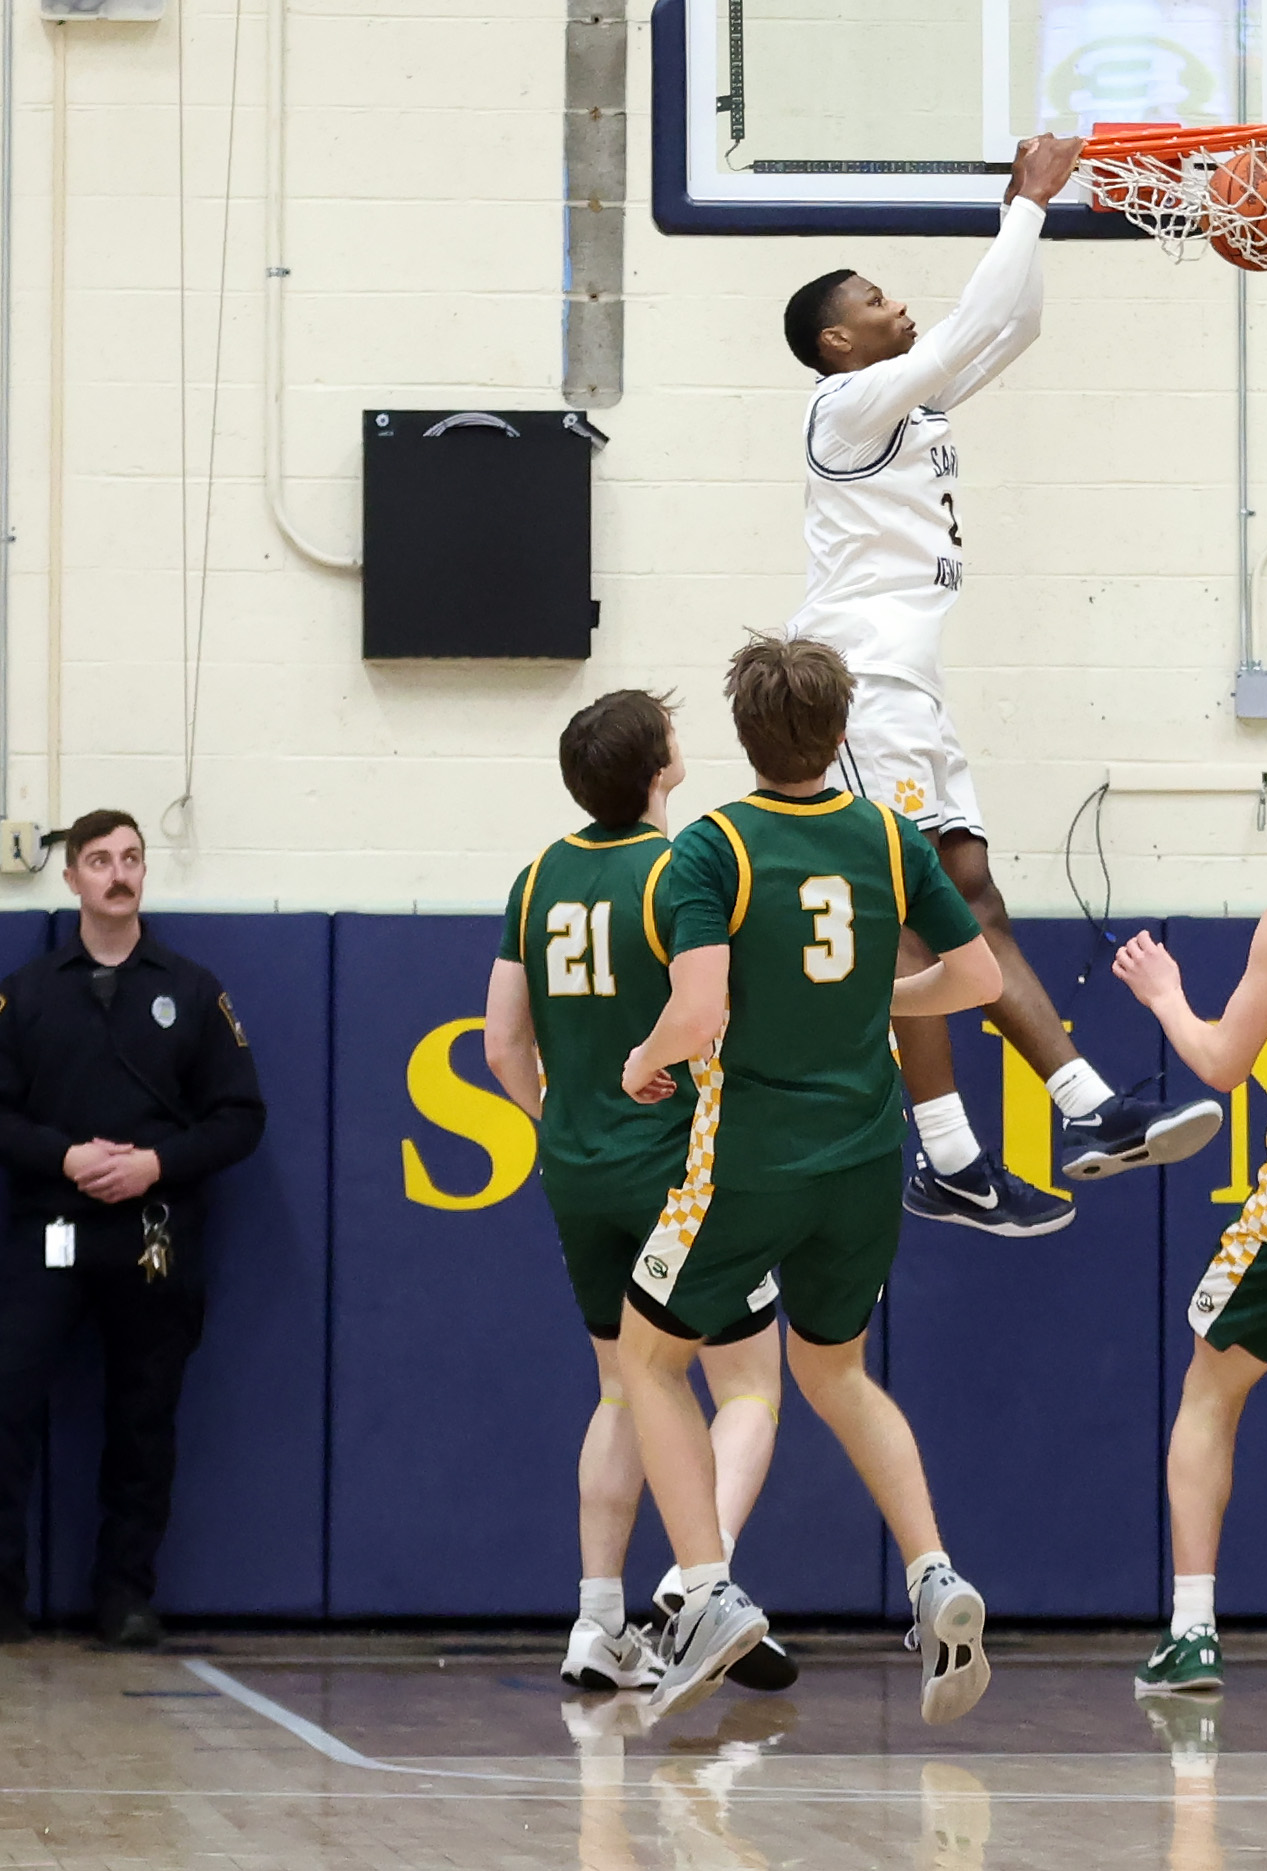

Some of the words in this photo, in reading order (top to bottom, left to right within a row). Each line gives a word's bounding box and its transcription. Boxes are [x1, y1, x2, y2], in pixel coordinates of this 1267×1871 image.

[940, 491, 962, 547] 2
[546, 901, 617, 997] 21
[799, 875, 856, 984] 3
